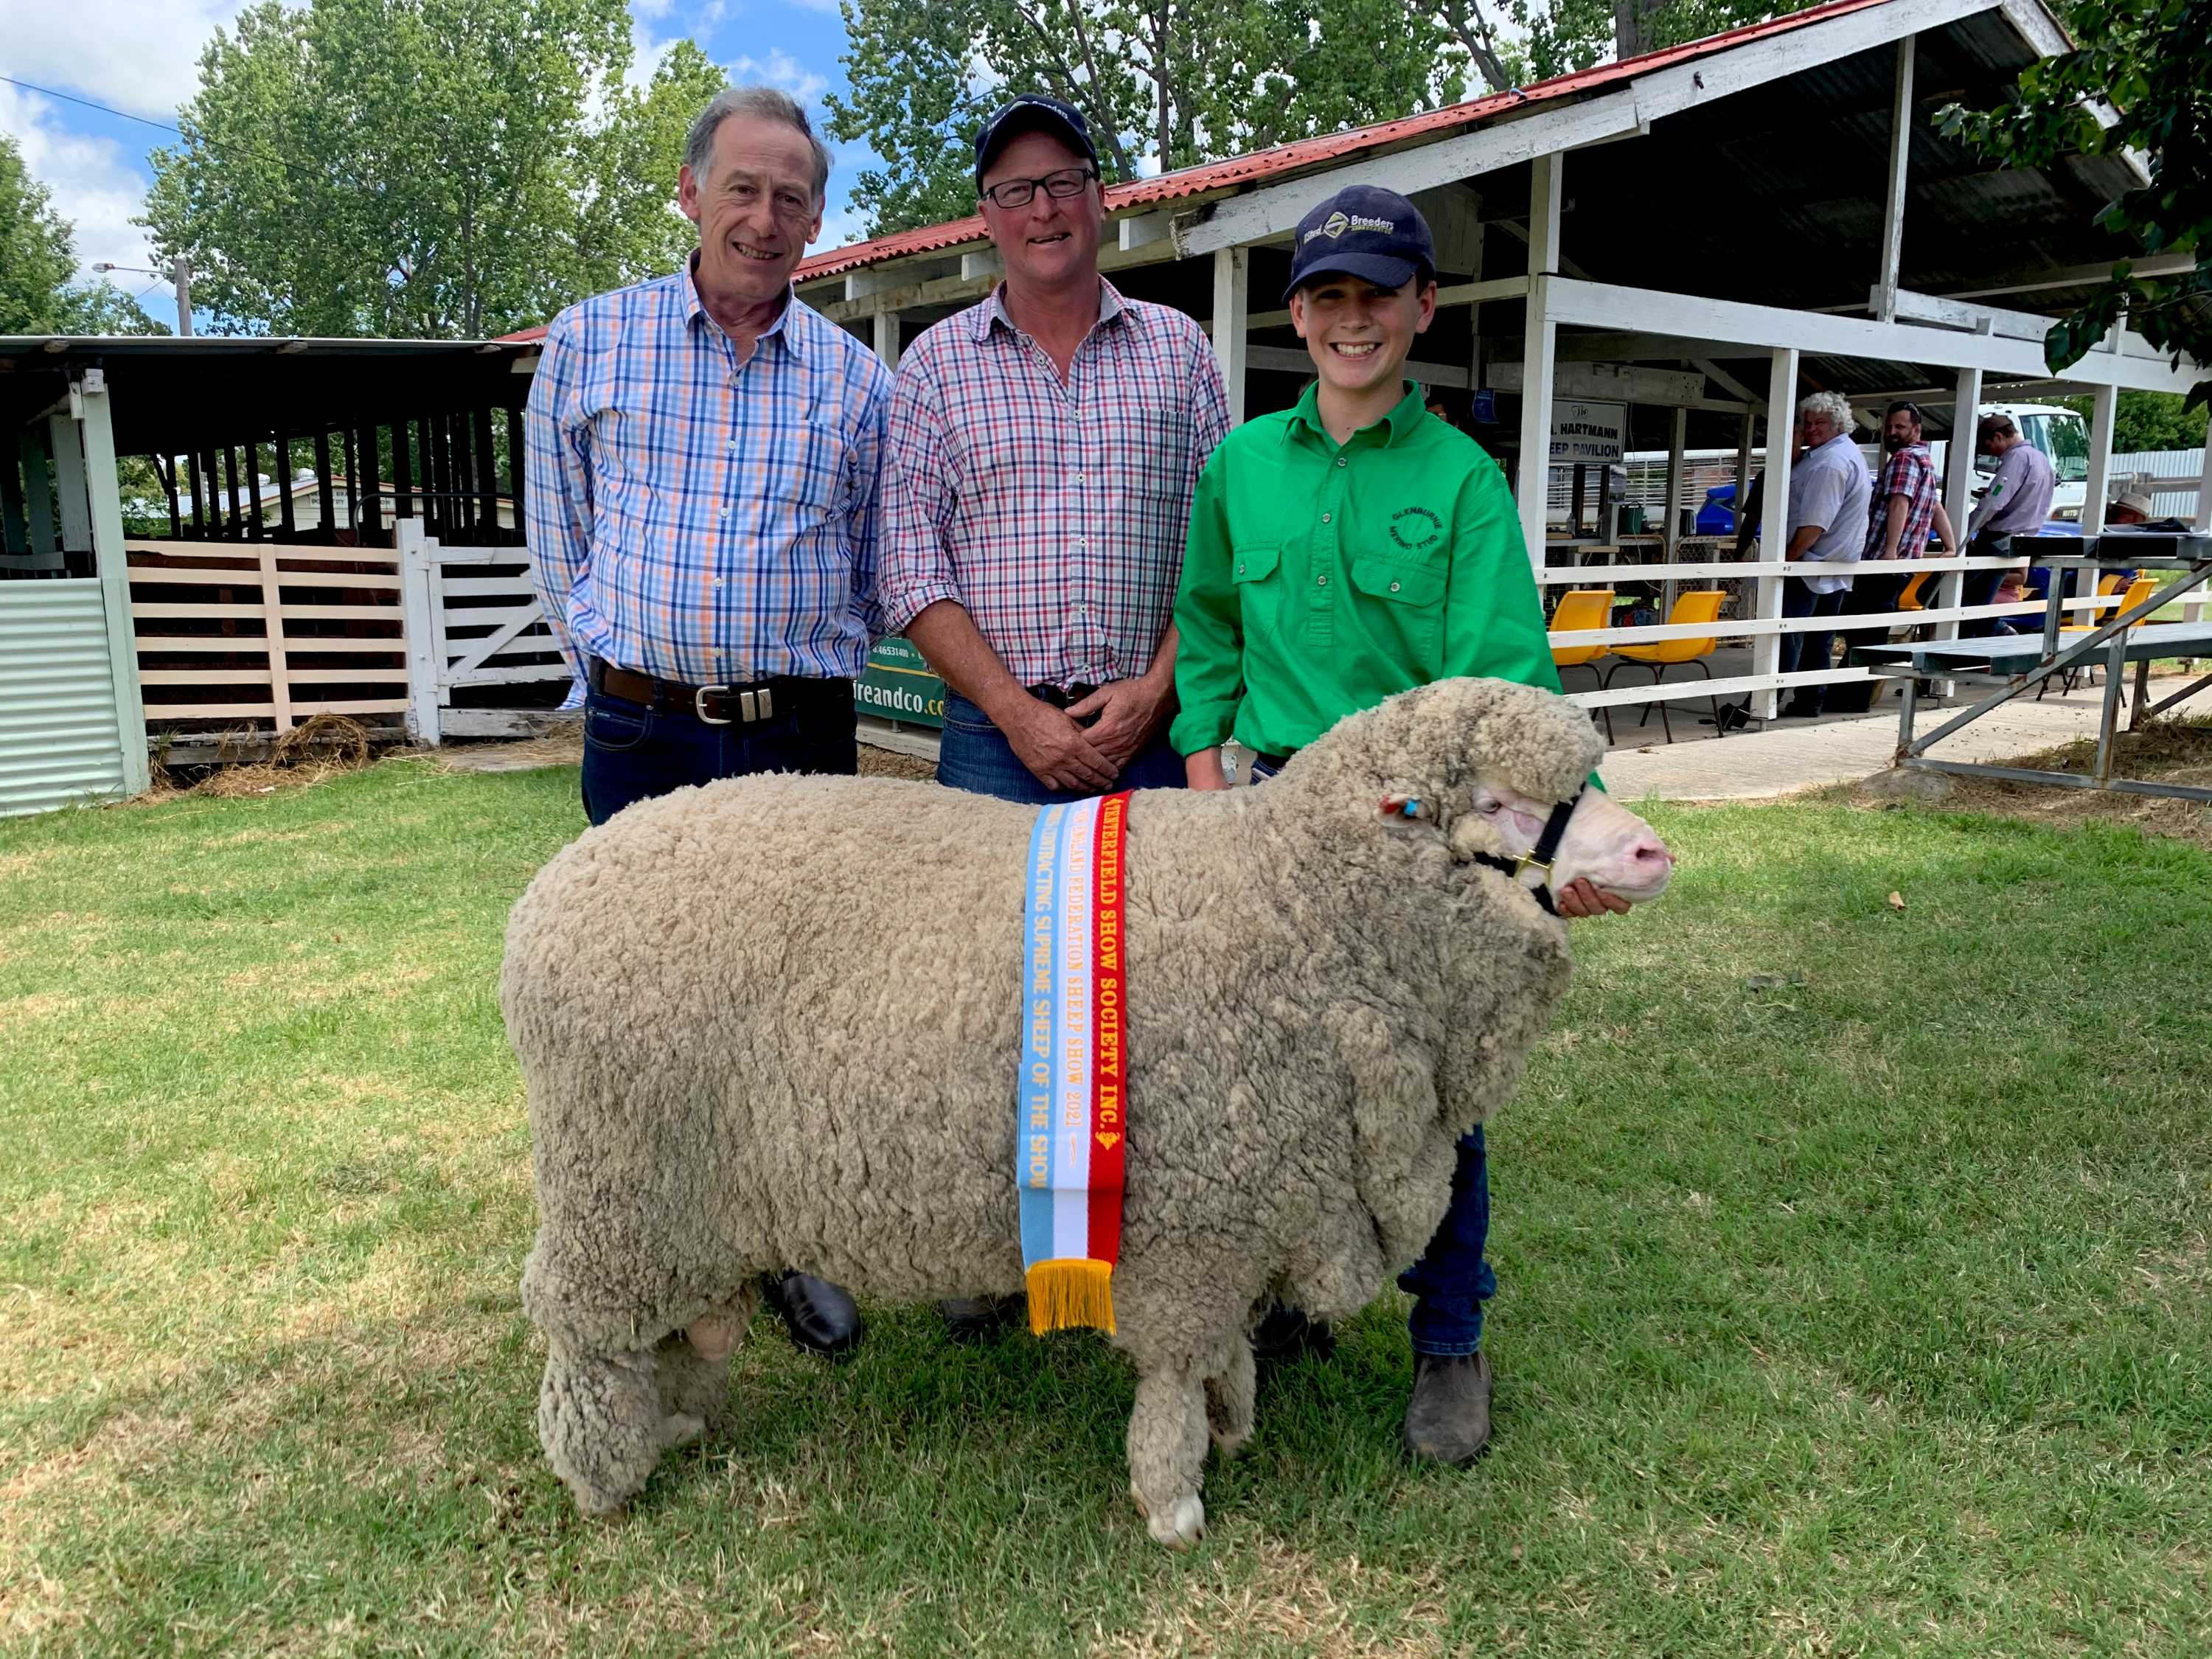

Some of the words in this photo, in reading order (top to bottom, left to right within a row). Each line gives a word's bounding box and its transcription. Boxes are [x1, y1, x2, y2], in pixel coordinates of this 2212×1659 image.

[1351, 215, 1394, 230] Breeders
[1560, 422, 1618, 439] HARTMANN
[1573, 443, 1619, 457] PAVILION
[1416, 535, 1438, 549] STUD
[1068, 825, 1088, 873] ENGLAND
[1101, 804, 1121, 905] TENTERFIELD
[1066, 875, 1085, 971] FEDERATION
[1099, 910, 1118, 972] SHOW
[1033, 915, 1052, 995] SUPREME
[1066, 975, 1084, 1034] SHEEP
[1100, 978, 1119, 1078] SOCIETY
[1032, 998, 1051, 1060] SHEEP
[1032, 1062, 1050, 1089] OF
[1065, 1037, 1084, 1086] SHOW
[1030, 1092, 1050, 1132] THE
[1065, 1091, 1082, 1127] 2021
[1099, 1084, 1118, 1130] INC.
